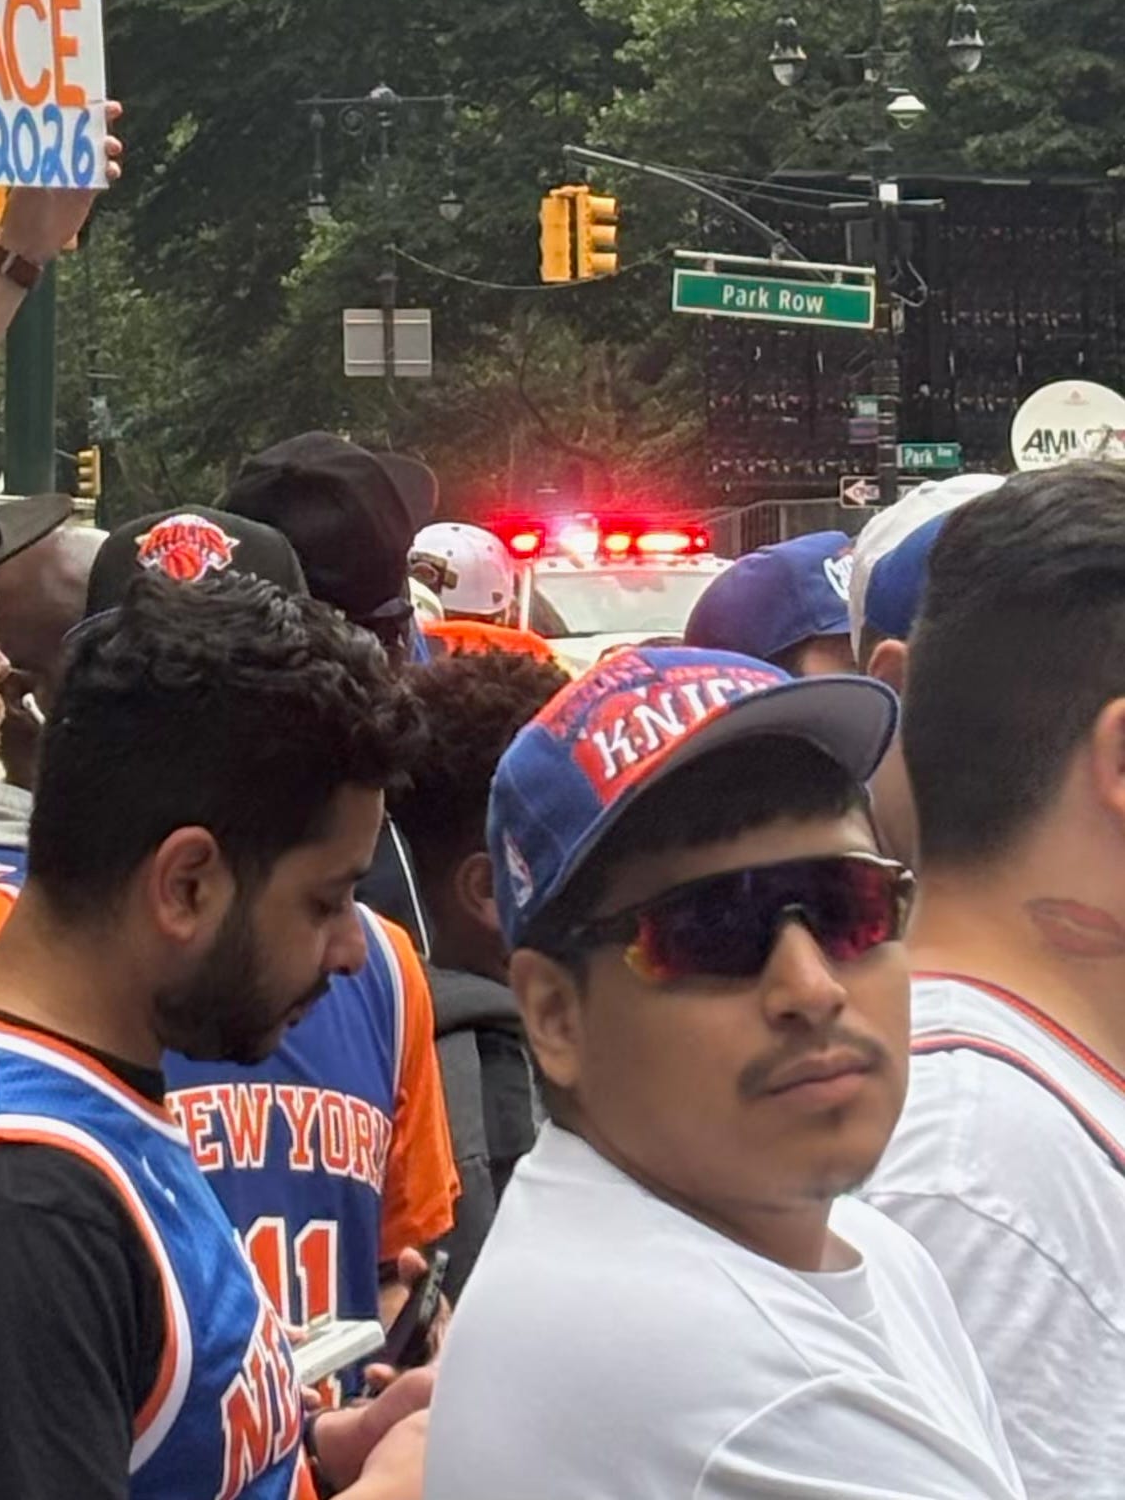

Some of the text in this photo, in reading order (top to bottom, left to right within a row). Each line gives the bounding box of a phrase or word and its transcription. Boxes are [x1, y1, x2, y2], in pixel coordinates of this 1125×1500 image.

[722, 283, 824, 314] Park Row
[904, 448, 934, 465] Park
[165, 1083, 272, 1172] EW
